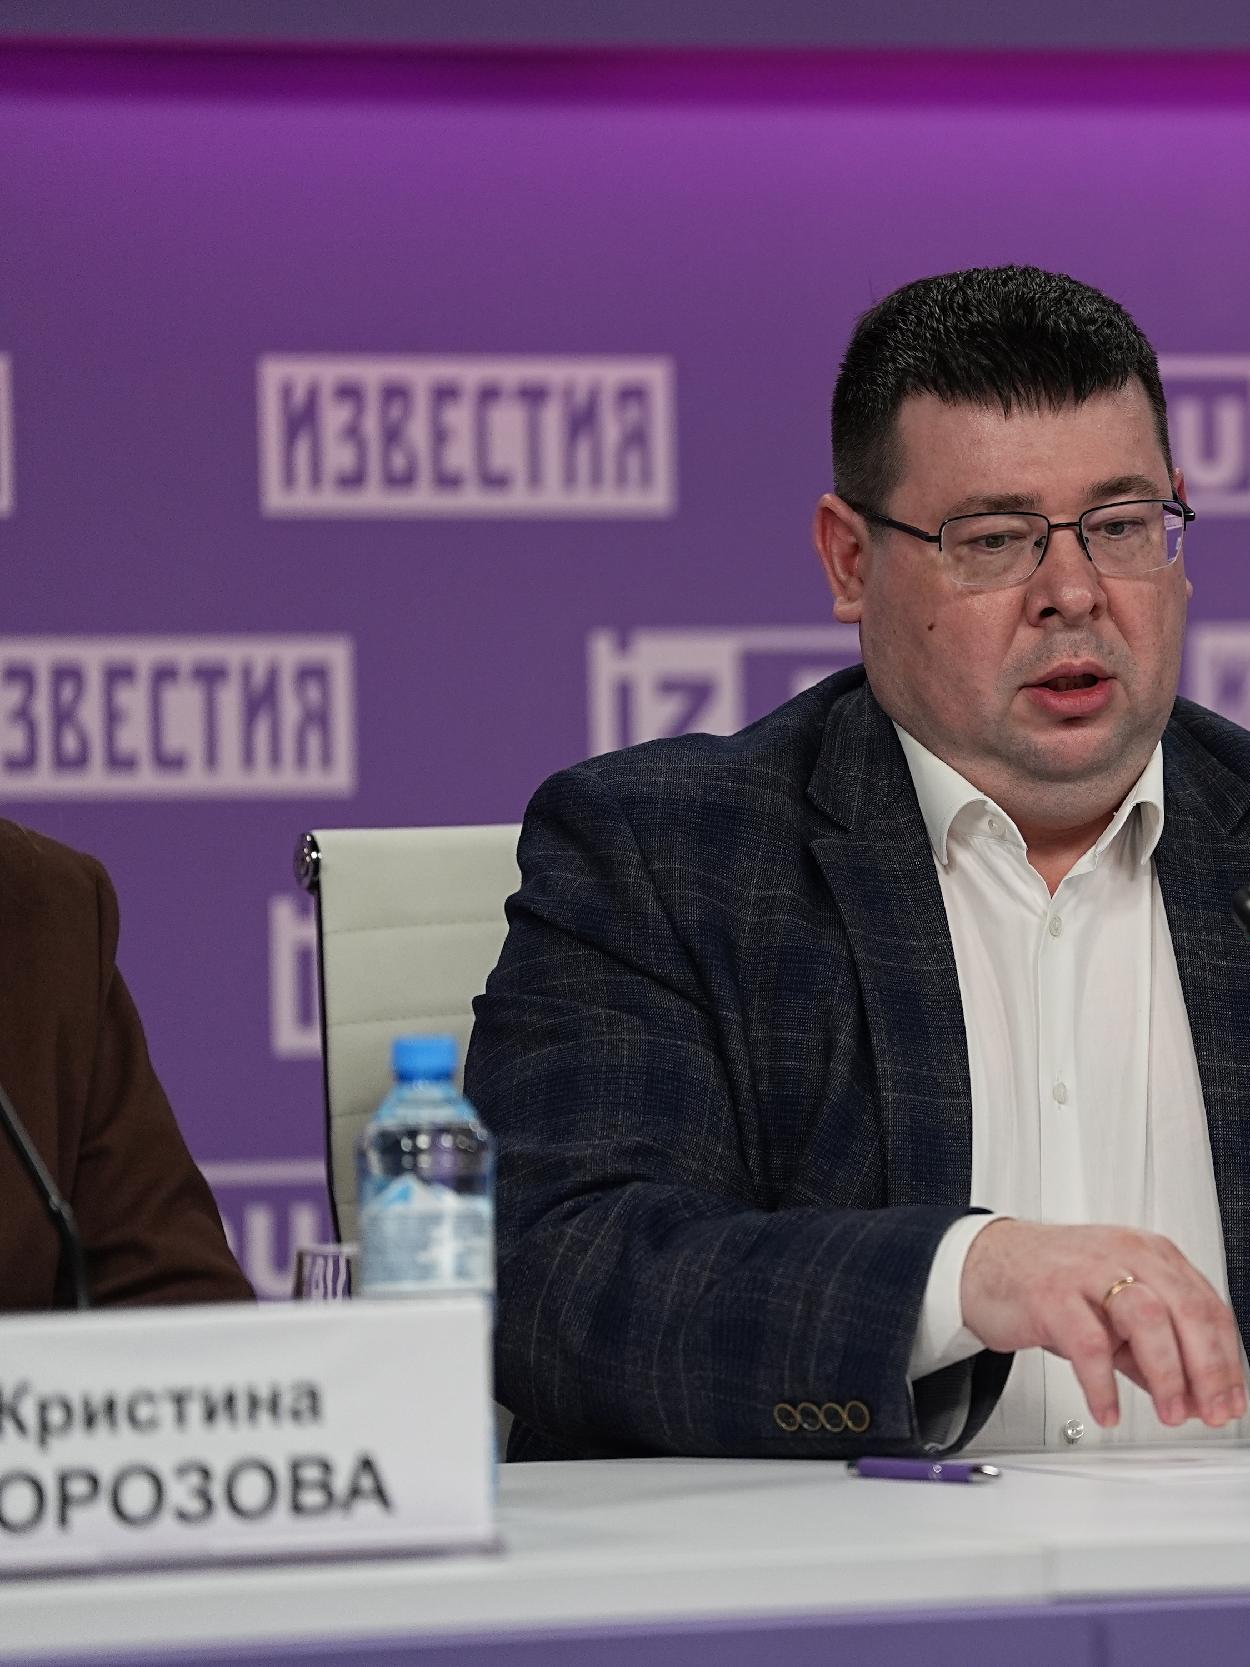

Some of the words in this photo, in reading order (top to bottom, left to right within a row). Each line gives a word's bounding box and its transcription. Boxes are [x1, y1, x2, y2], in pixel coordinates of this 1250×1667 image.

[280, 376, 654, 493] ИЗВЕСТИЯ
[1168, 398, 1241, 486] U
[0, 655, 335, 778] ЗВЕСТИЯ
[0, 1446, 396, 1537] ОРОЗОВА
